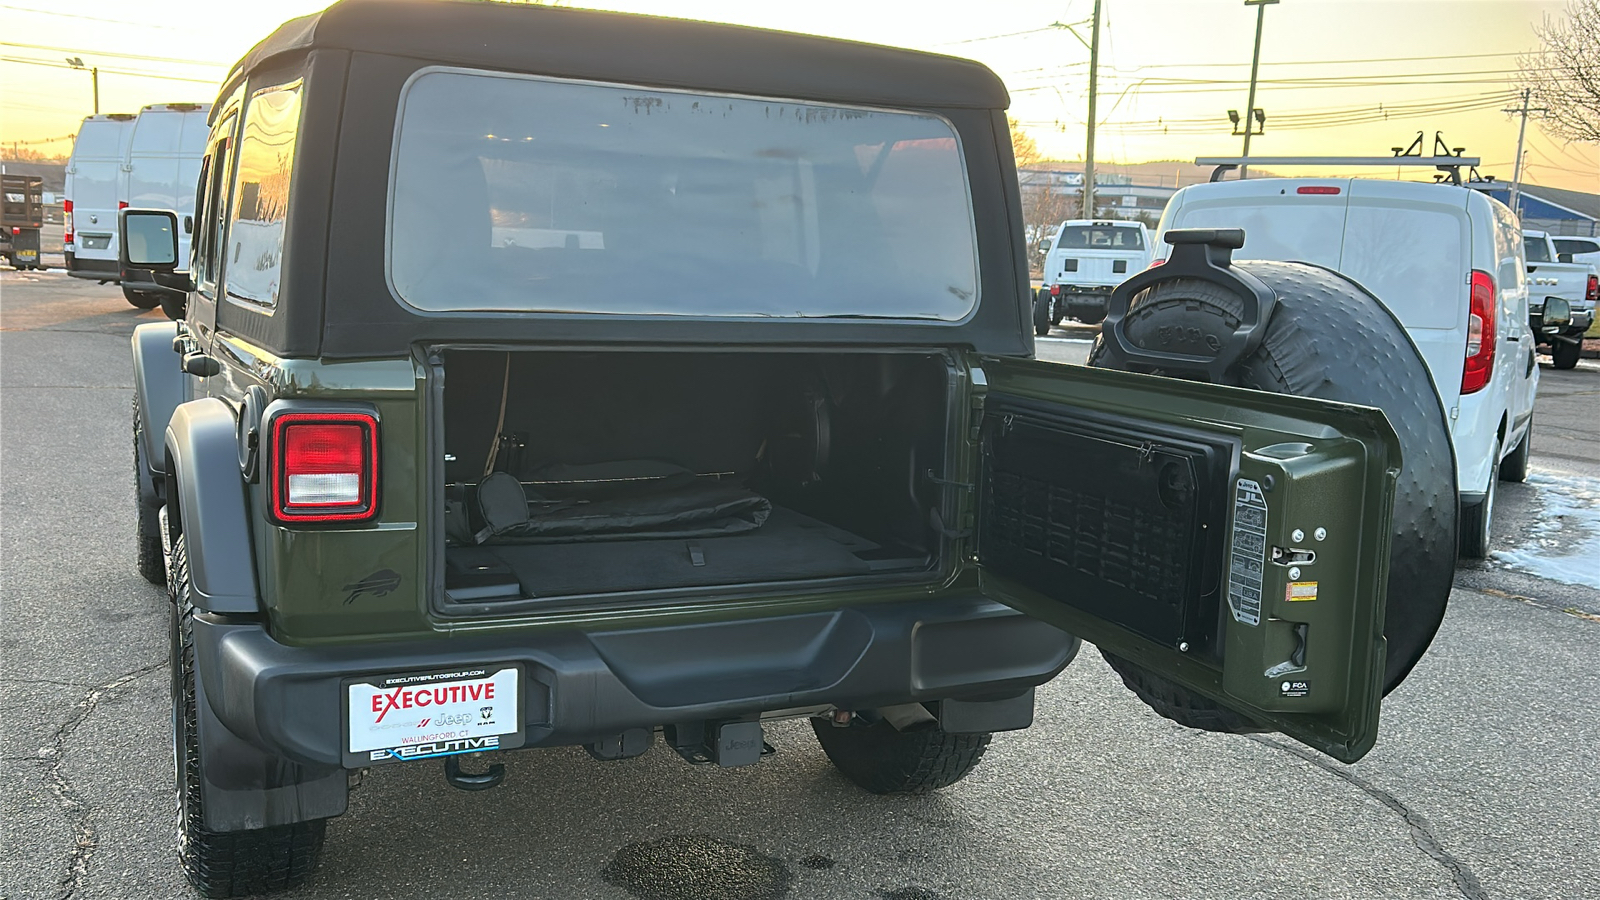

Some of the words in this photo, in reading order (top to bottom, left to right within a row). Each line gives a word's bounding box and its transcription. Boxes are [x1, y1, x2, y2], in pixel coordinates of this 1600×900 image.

[1237, 491, 1263, 503] JL
[1243, 589, 1258, 599] USA
[386, 669, 485, 684] EXECUTIVEAUTOGROUP.COM
[372, 682, 495, 723] EXECUTIVE
[435, 712, 473, 727] Jeep
[459, 730, 469, 738] CT
[370, 736, 500, 761] EXECUTIVE
[725, 738, 757, 751] Jeep
